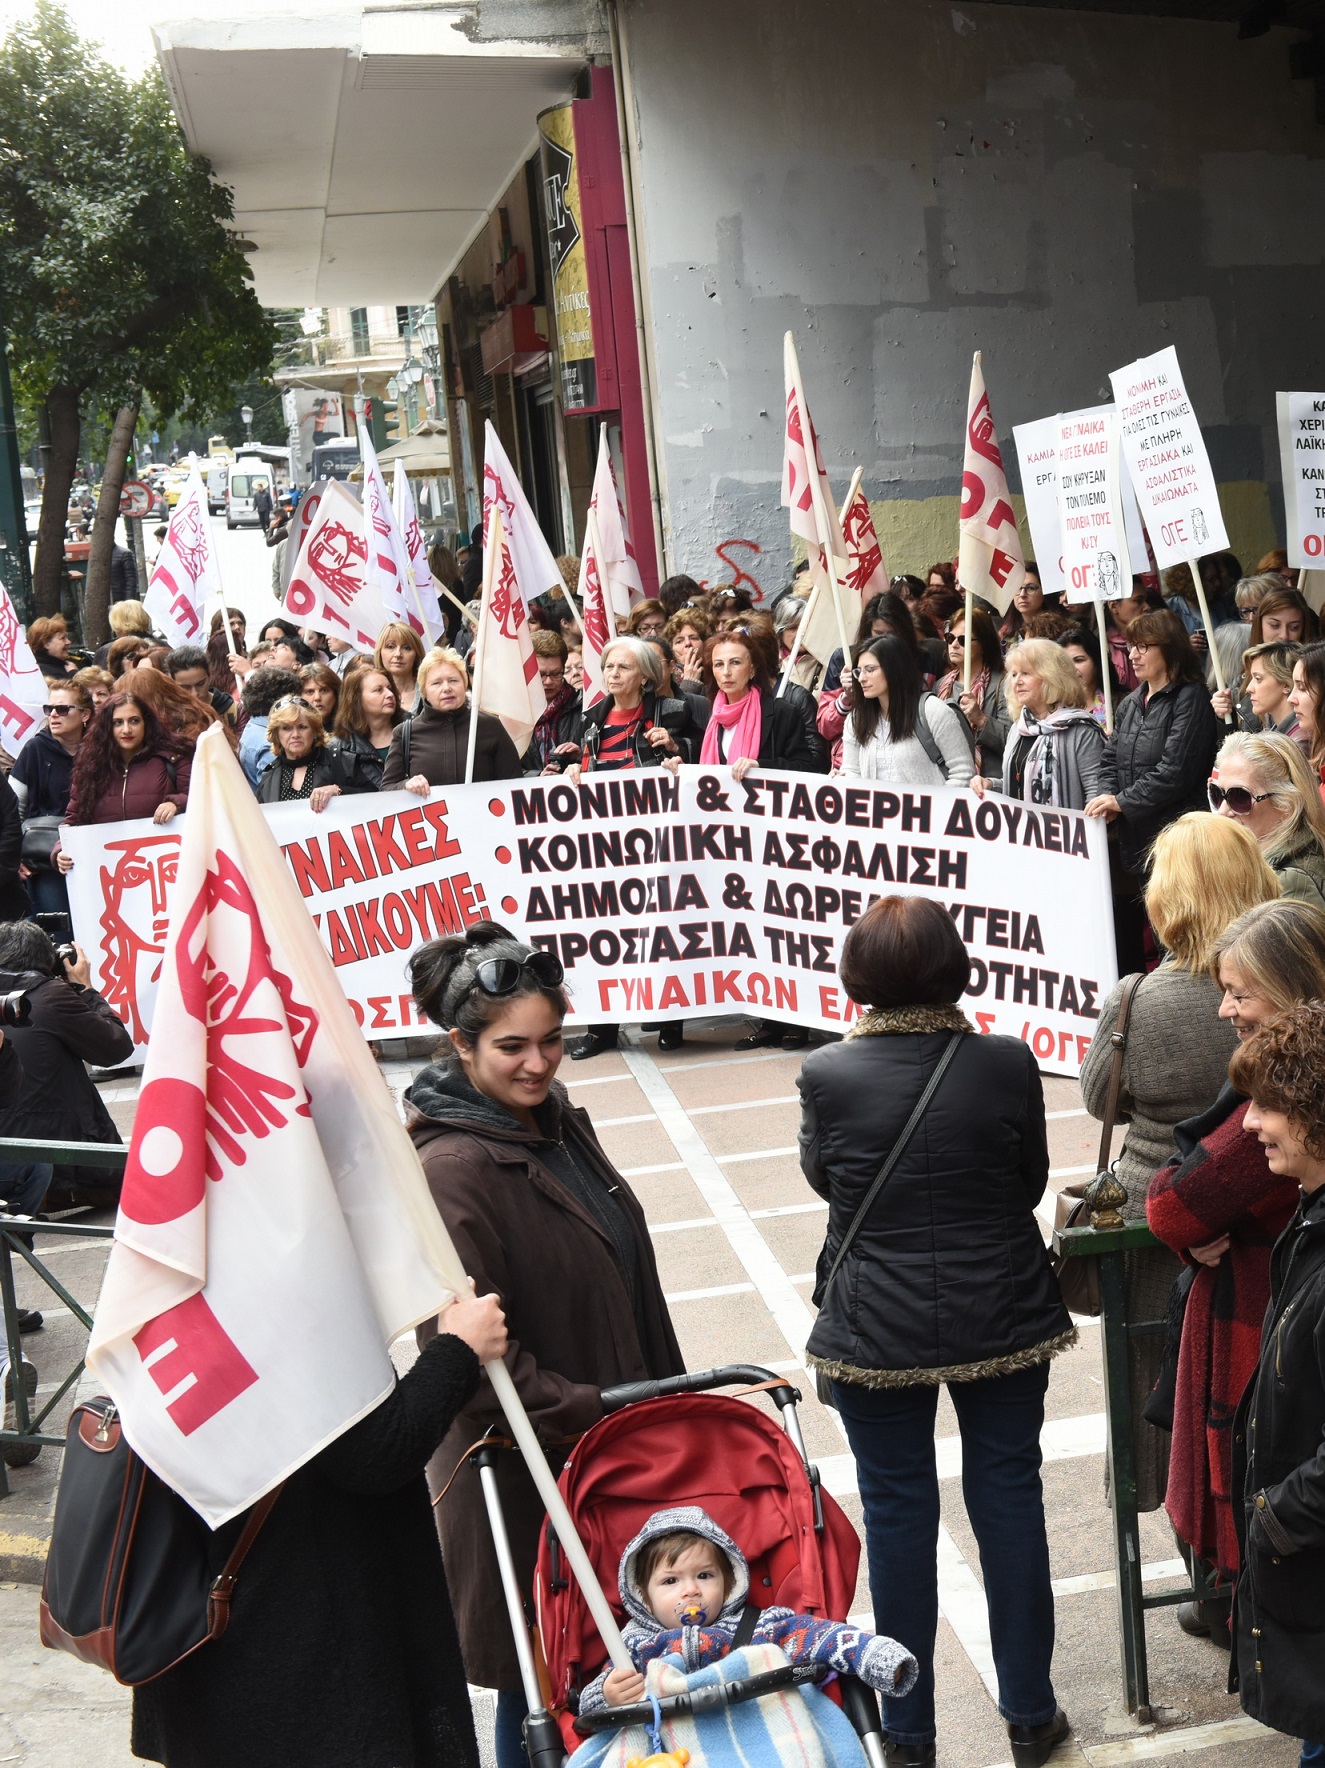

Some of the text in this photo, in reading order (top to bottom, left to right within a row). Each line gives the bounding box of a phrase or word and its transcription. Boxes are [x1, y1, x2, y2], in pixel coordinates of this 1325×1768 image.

[1157, 372, 1169, 387] ΚΑΙ
[1121, 387, 1183, 421] ΣΤΑΘΕΡΗ ΕΡΓΑΣΙΑ
[1146, 413, 1160, 428] ΤΙΣ
[1160, 402, 1190, 423] ΓΥΝΑΙΚΕΣ
[1082, 440, 1108, 456] ΚΑΛΕΙ
[1150, 428, 1183, 449] ΠΛΗΡΗ
[1137, 443, 1195, 472] ΕΡΓΑΣΙΑΚΑ ΚΑΙ
[1074, 469, 1106, 487] ΚΗΡΥΞΑΝ
[1145, 464, 1197, 491] ΑΣΦΑΛΙΣΤΙΚΑ
[1066, 495, 1080, 510] ΤΟΝ
[1152, 481, 1199, 506] ΔΙΚΑΙΩΜΑΤΑ
[1090, 511, 1111, 527] ΤΟΥΣ
[1160, 518, 1189, 548] ΟΓΕ
[510, 774, 1090, 860] ΜΟΝΙΜΗ & ΣΤΑΘΕΡΗ ΔΟΥΛΕΙΑ
[517, 823, 968, 890] ΚΟΙΝΩΝΙΚΗ ΑΣΦΑΛΙΣΗ
[525, 873, 710, 923] ΔΗΜΟΣΙΑ
[721, 872, 756, 912] &
[763, 879, 876, 926] ΔΩΡΕ
[530, 921, 1102, 1020] ΠΡΟΣΤΑΣΙΑ ΤΗΣ ΟΤΗΤΑΣ
[597, 969, 799, 1013] ΓΥΝΑΙΚΩΝ
